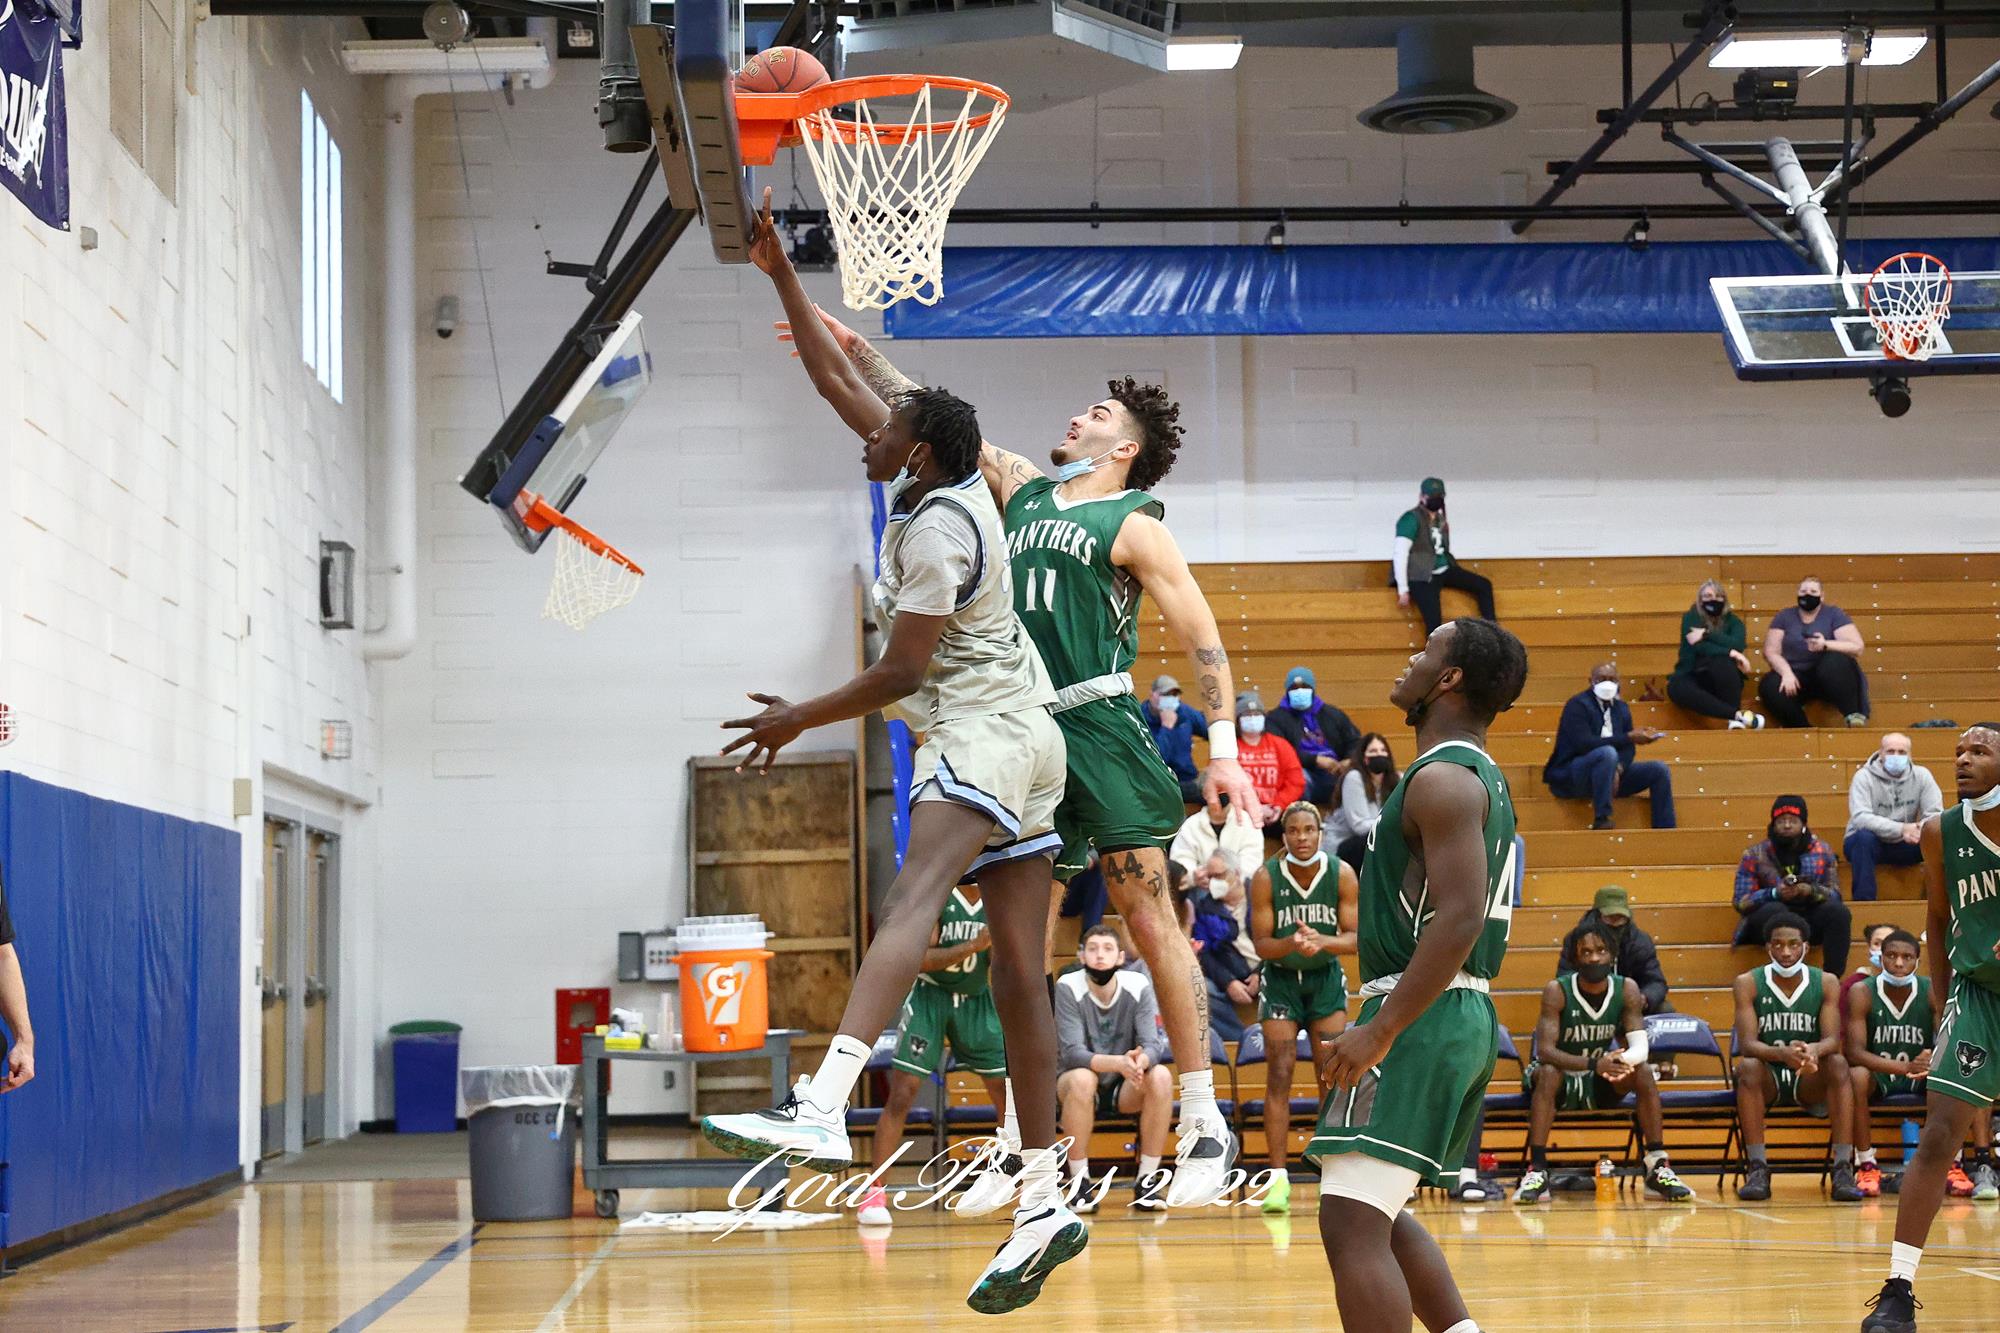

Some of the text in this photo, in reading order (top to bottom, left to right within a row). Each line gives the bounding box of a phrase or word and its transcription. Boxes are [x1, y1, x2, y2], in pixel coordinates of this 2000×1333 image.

[1007, 520, 1097, 566] PANTHERS
[1024, 567, 1057, 612] 11
[1105, 851, 1145, 884] 44
[1277, 903, 1337, 929] PANTHERS
[707, 966, 737, 998] G
